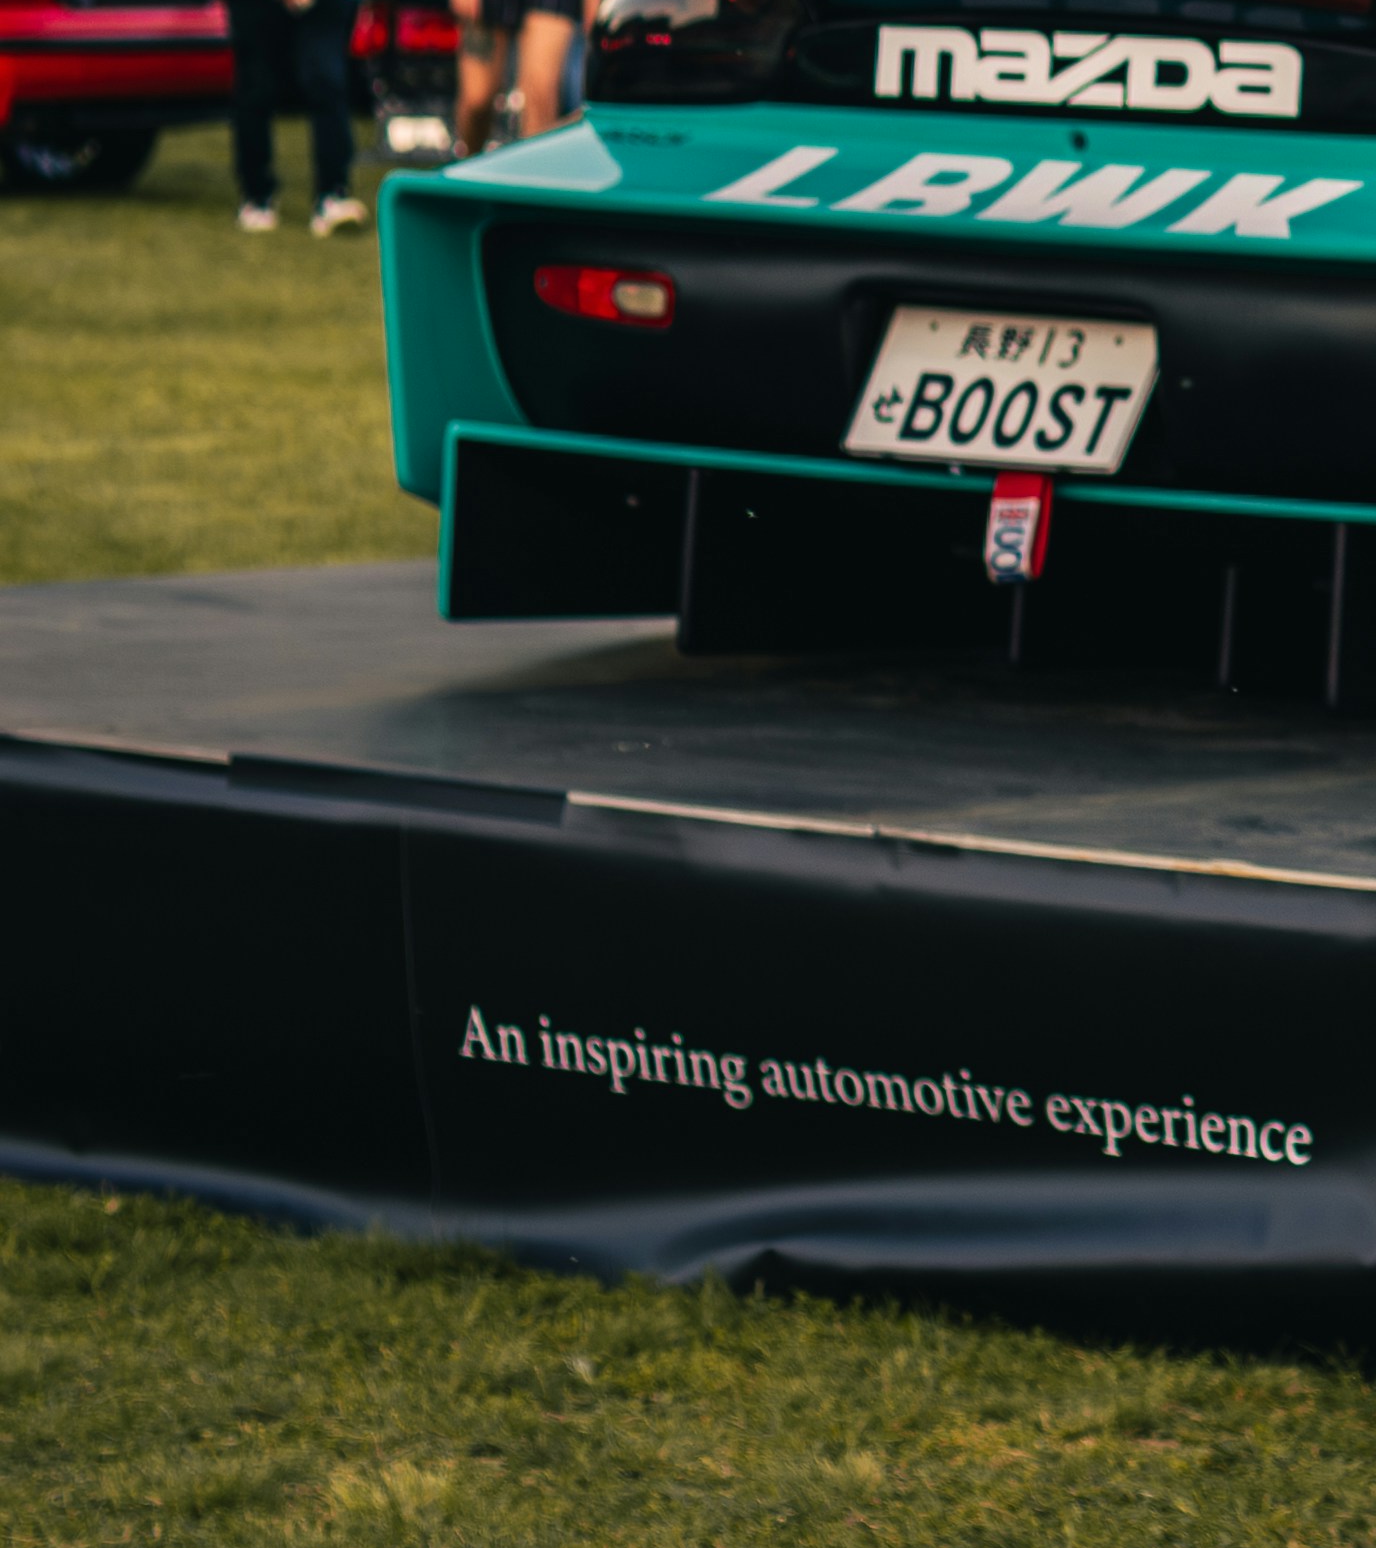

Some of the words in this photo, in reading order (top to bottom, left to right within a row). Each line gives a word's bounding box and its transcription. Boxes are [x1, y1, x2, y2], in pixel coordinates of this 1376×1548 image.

[701, 145, 1365, 240] LBWK
[897, 371, 1133, 457] BOOST
[459, 1005, 530, 1066] An
[538, 1014, 754, 1109] inspiring
[759, 1056, 1036, 1126] automotive
[1045, 1094, 1314, 1166] experience
